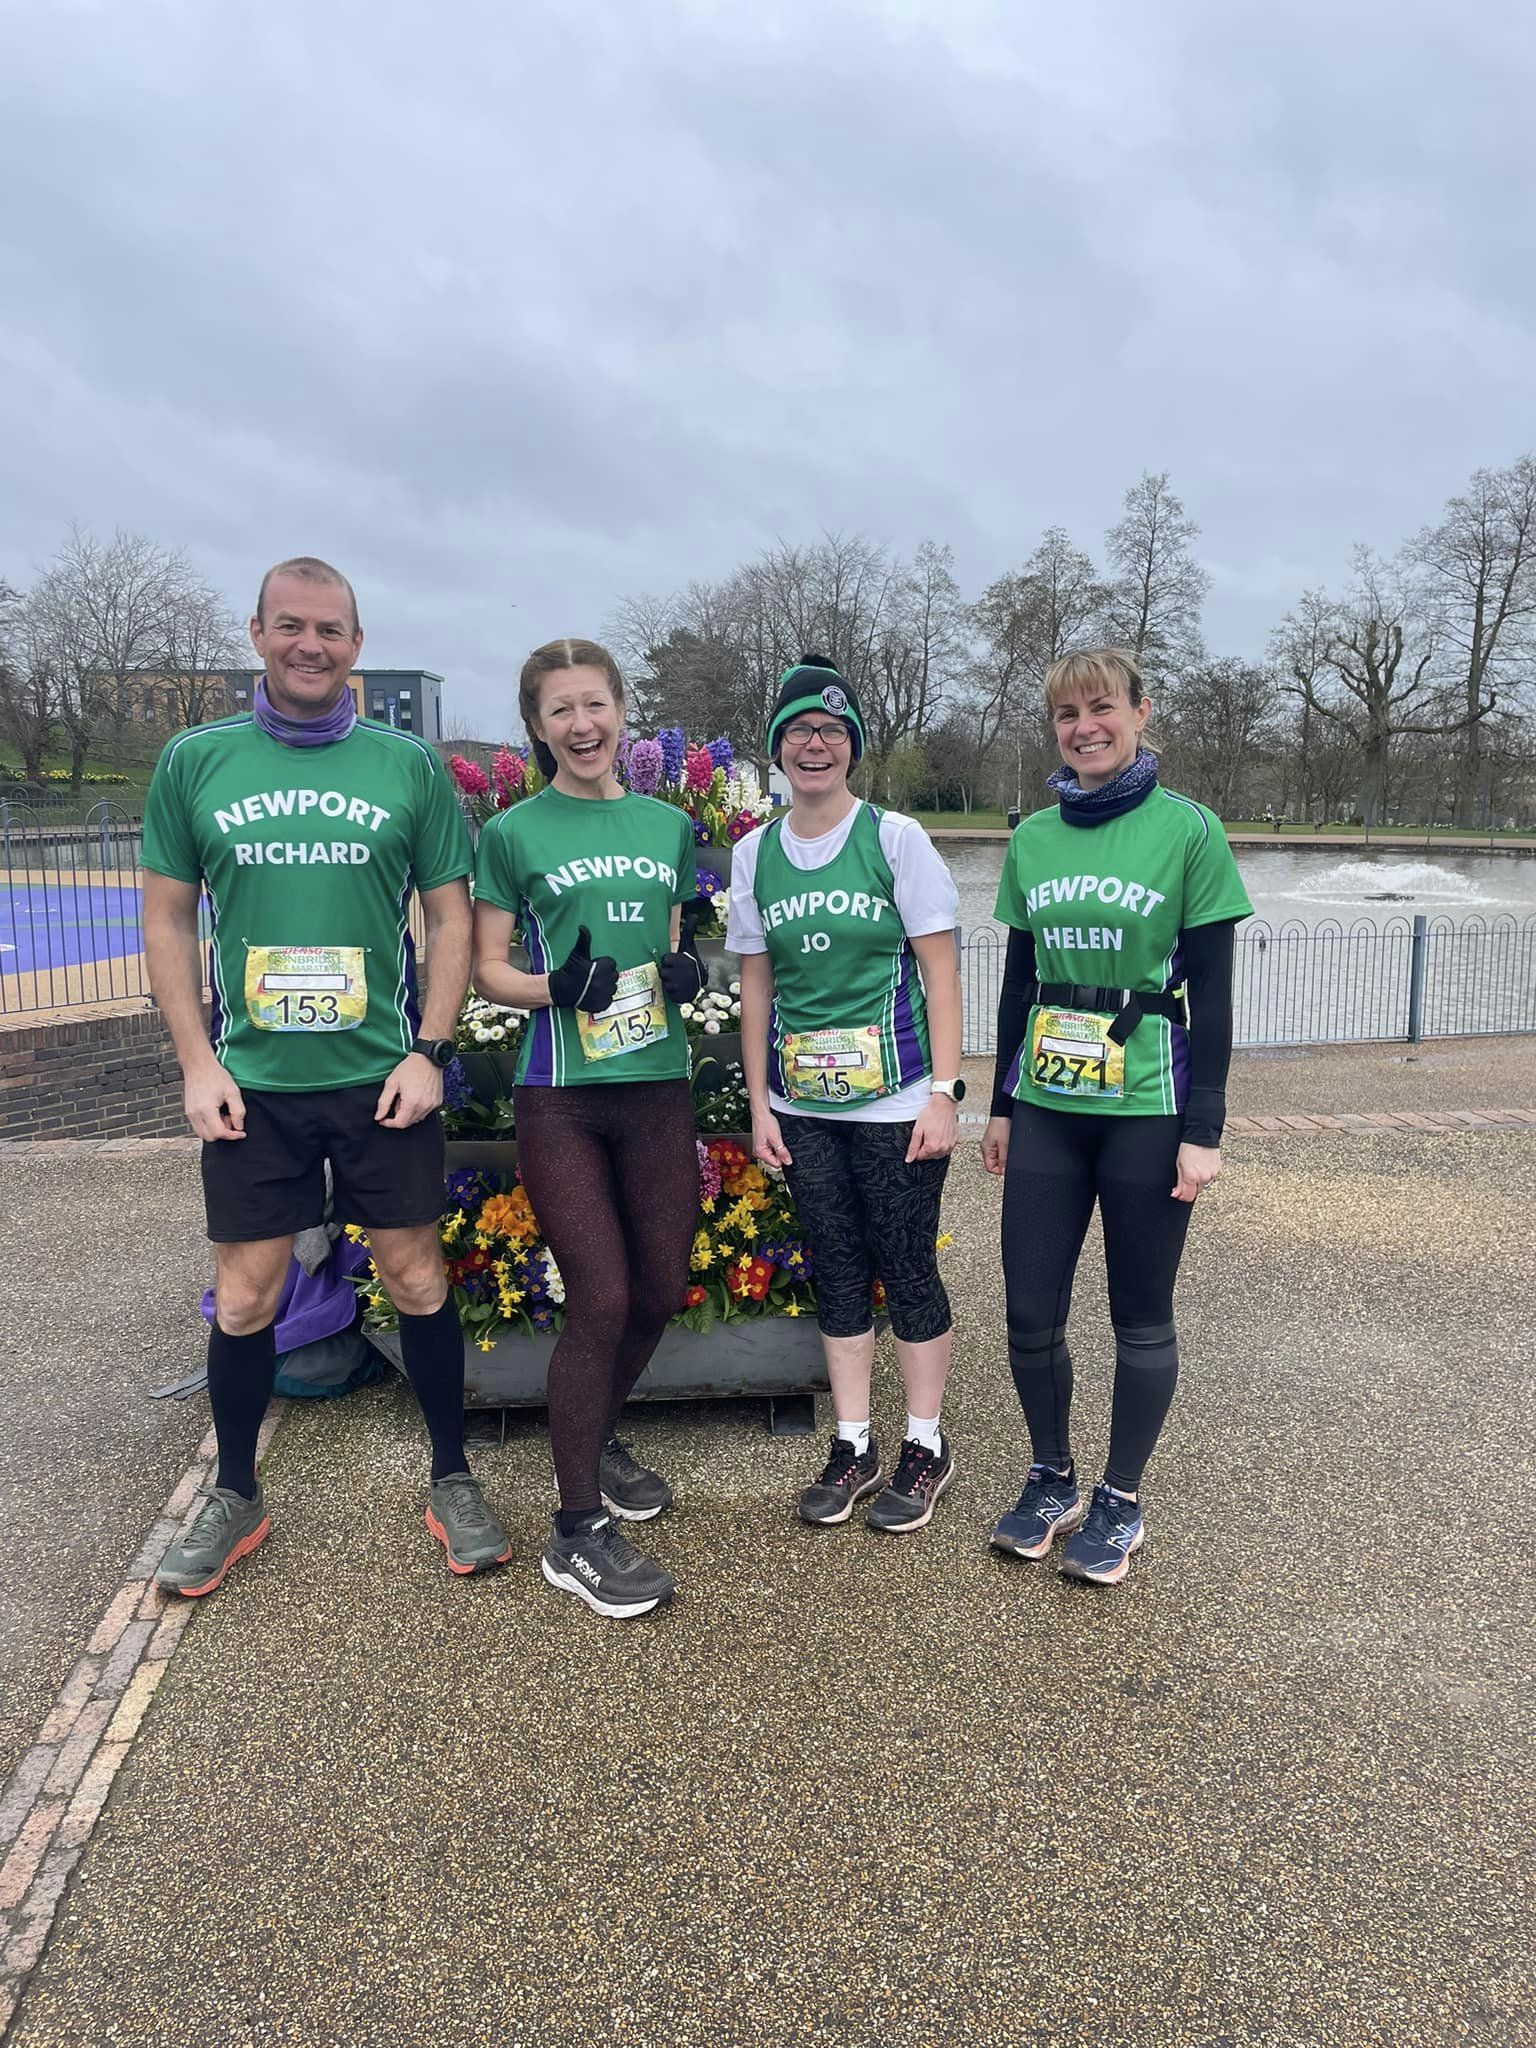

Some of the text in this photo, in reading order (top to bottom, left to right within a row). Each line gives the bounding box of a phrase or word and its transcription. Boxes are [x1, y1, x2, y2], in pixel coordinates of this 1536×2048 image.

[213, 789, 391, 834] NEWPORT
[234, 841, 370, 866] RICHARD
[607, 901, 645, 922] LIZ
[761, 889, 889, 938] NEWPORT
[1025, 875, 1166, 919] NEWPORT
[801, 932, 831, 954] JO
[1042, 927, 1123, 951] HELEN
[276, 995, 339, 1025] 153
[609, 1009, 654, 1047] 152
[817, 1071, 851, 1097] 15
[1034, 1051, 1106, 1090] 2271
[570, 1552, 602, 1588] HOKA
